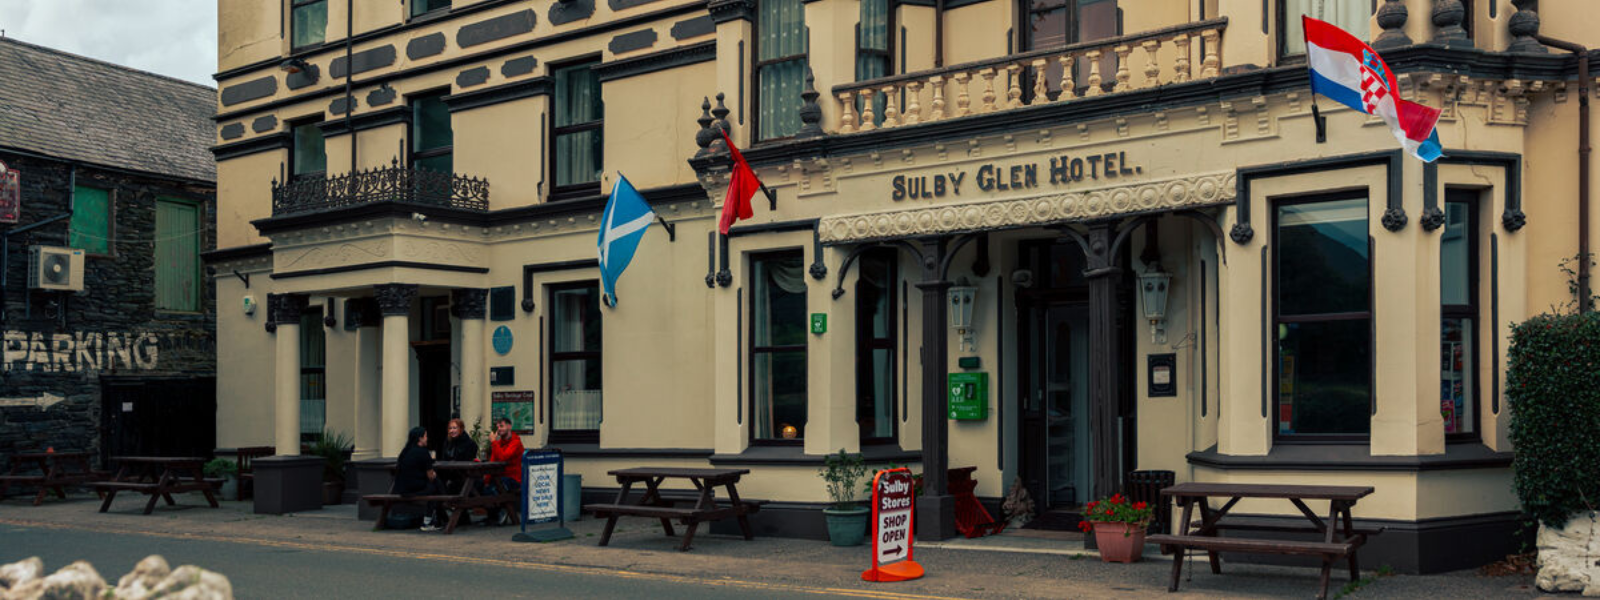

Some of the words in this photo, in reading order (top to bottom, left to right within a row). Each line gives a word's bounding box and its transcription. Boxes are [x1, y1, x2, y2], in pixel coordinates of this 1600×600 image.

[3, 329, 159, 373] PARKING
[535, 481, 551, 489] LOCAL
[883, 479, 910, 495] Sulby
[881, 496, 911, 510] Stores
[883, 514, 908, 529] SHOP
[882, 528, 906, 544] OPEN
